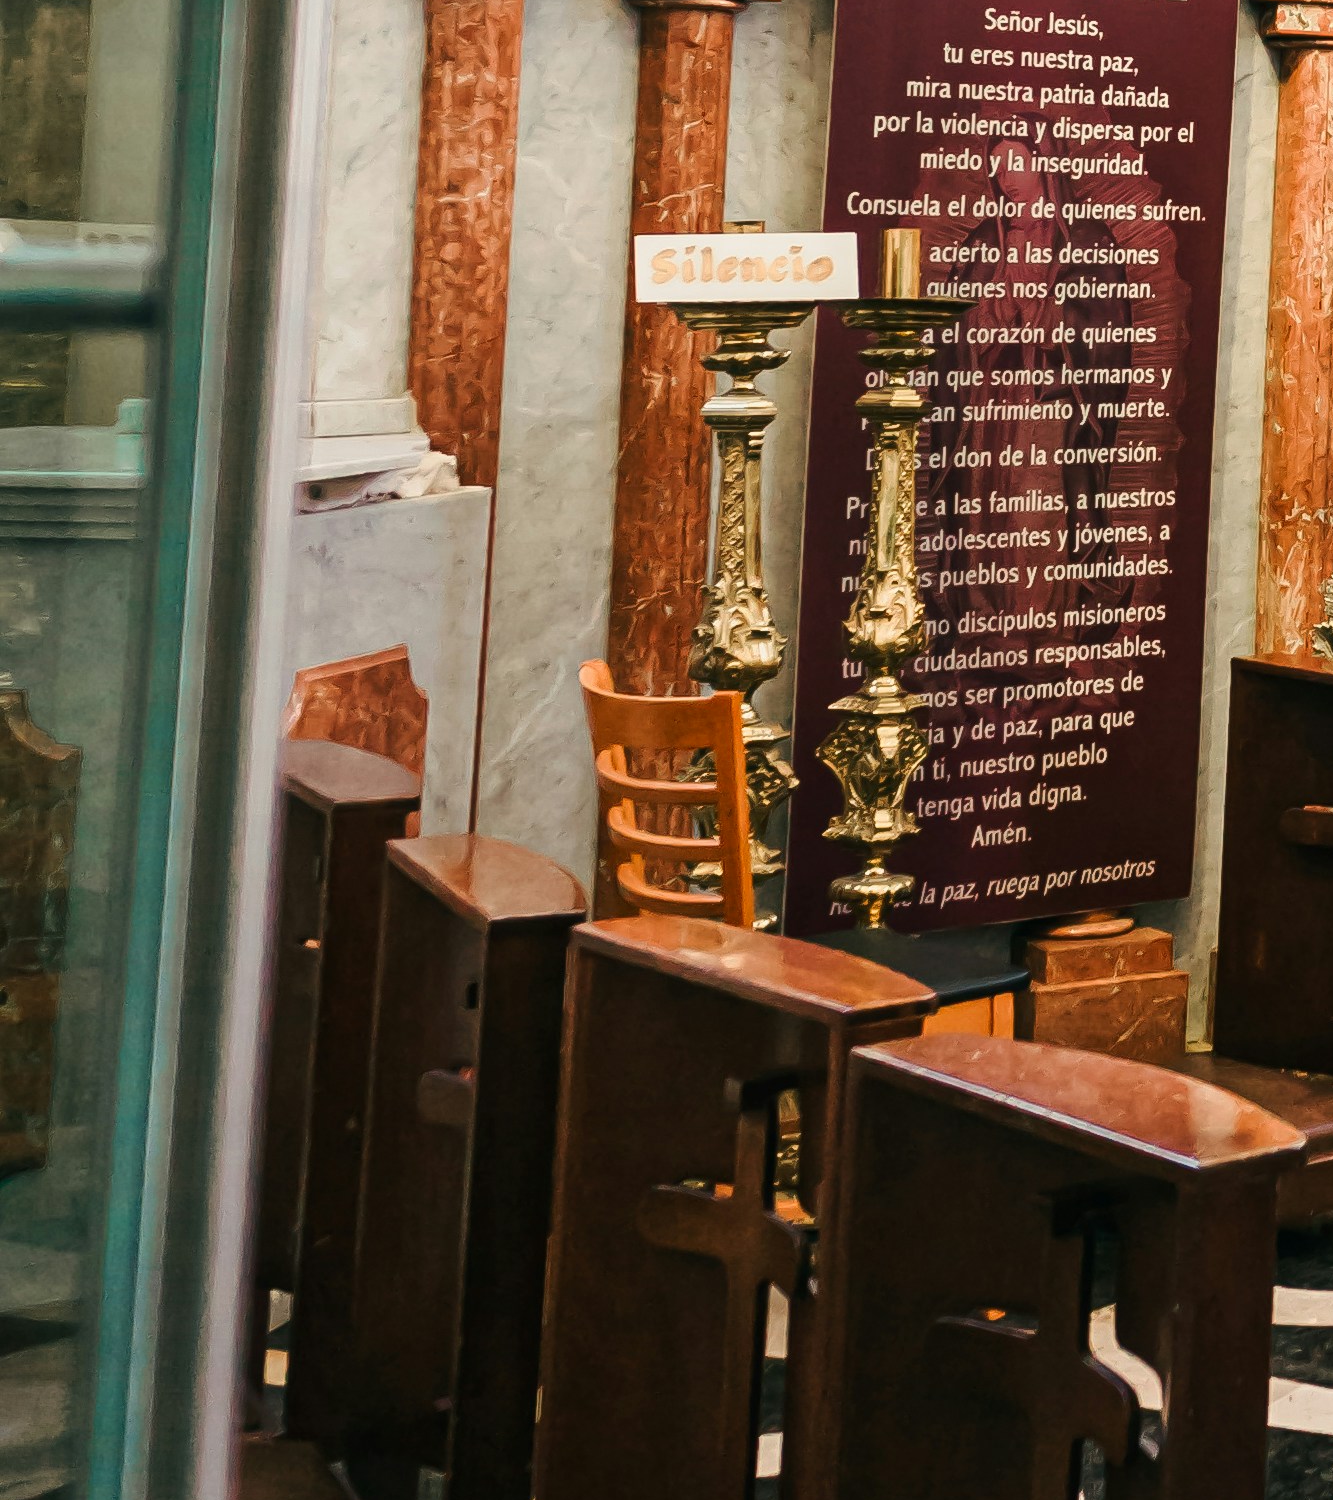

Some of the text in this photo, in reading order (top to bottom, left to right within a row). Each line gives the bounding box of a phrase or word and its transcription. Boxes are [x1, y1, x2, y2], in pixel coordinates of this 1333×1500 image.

[985, 8, 1103, 40] Señor Jesús,
[943, 43, 1138, 77] tu eres nuestra paz,
[907, 76, 1169, 109] mira nuestra patria dañada
[874, 111, 1194, 147] por la violencia y dispersa por el
[921, 148, 1148, 179] miedo y la inseguridad.
[847, 192, 1205, 225] Consuela el dolor de quienes sufren.
[650, 244, 835, 285] Silencio
[930, 241, 1159, 264] acierto a las decisiones
[1013, 283, 1047, 298] nos
[1055, 276, 1155, 305] gobiernan.
[942, 322, 959, 343] el
[967, 322, 1044, 344] corazón
[1052, 321, 1075, 343] de
[1082, 322, 1156, 349] quienes
[947, 371, 984, 392] que
[991, 370, 1054, 385] somos
[1061, 363, 1155, 384] hermanos
[1161, 368, 1172, 389] y
[963, 399, 1072, 421] sufrimiento
[1080, 404, 1091, 425] y
[1098, 398, 1169, 418] muerte.
[929, 446, 946, 468] el
[954, 446, 991, 467] don
[999, 445, 1023, 466] de
[1031, 444, 1047, 465] la
[1054, 441, 1161, 464] conversión.
[935, 500, 945, 515] a
[955, 493, 981, 514] las
[989, 490, 1068, 514] familias,
[1077, 494, 1087, 509] a
[1095, 488, 1175, 508] nuestros
[919, 523, 1170, 552] adolescentes y jóvenes, a
[940, 562, 1019, 593] pueblos
[1026, 566, 1037, 588] y
[1044, 554, 1172, 581] comunidades.
[958, 607, 1056, 637] discípulos
[1064, 603, 1165, 627] misioneros
[914, 646, 1027, 672] ciudadanos
[1036, 635, 1165, 668] responsables,
[965, 688, 997, 704] ser
[1004, 677, 1114, 708] promotores
[1121, 670, 1143, 691] de
[952, 726, 964, 748] y
[972, 718, 995, 740] de
[1003, 719, 1042, 744] paz,
[1051, 715, 1092, 739] para
[1100, 711, 1134, 734] que
[933, 758, 950, 782] ti,
[960, 752, 1035, 777] nuestro
[1042, 742, 1107, 776] pueblo
[919, 783, 1086, 820] tenga vida digna.
[972, 822, 1031, 848] Amén.
[920, 882, 935, 904] la
[941, 883, 978, 909] paz,
[987, 875, 1039, 899] ruega
[1044, 870, 1077, 896] por
[1081, 860, 1155, 884] nosotros
